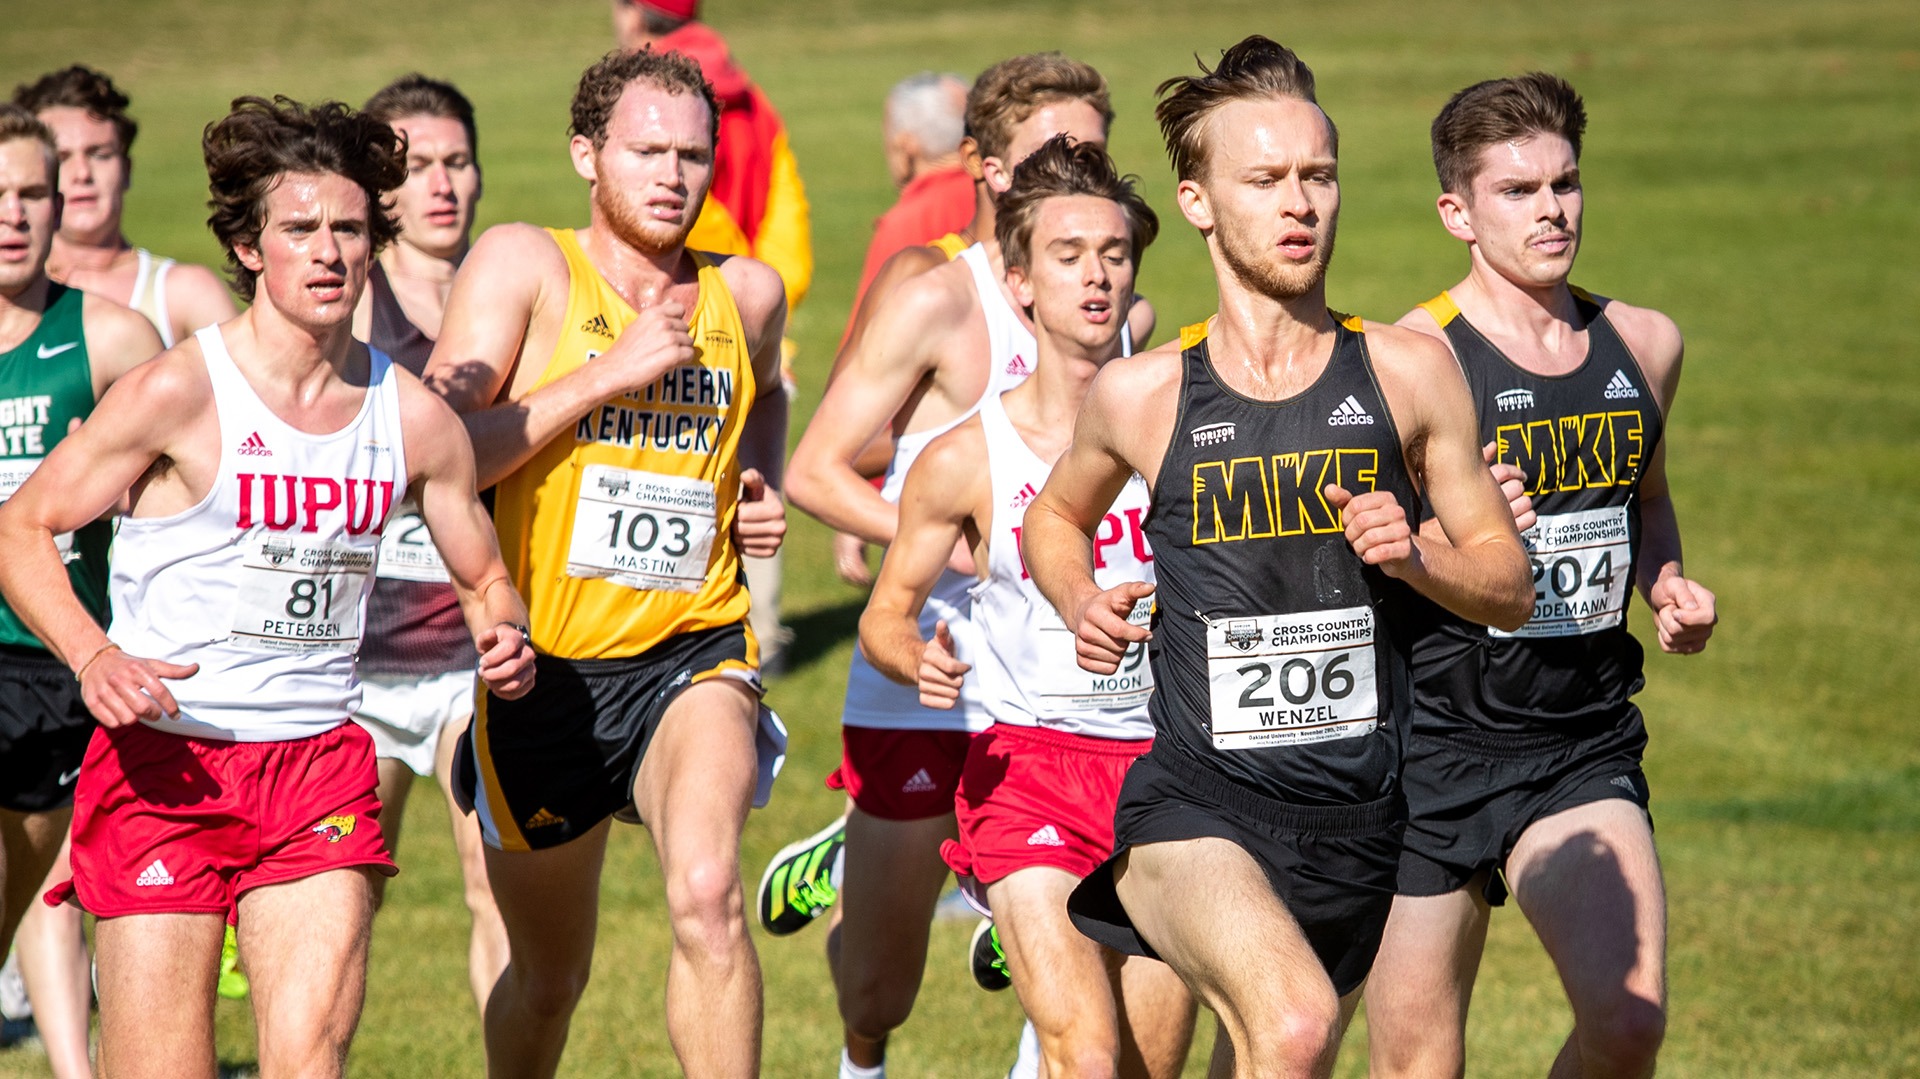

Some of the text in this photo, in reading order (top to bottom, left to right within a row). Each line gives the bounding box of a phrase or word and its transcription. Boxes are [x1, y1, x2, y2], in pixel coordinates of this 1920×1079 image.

[1604, 388, 1639, 399] adidas
[1328, 414, 1374, 426] adidas
[575, 404, 727, 455] KENTUCKY
[1192, 427, 1235, 442] HORIZON
[1194, 435, 1235, 448] LEAGUE
[237, 447, 272, 456] adidas
[1497, 410, 1643, 496] MKE
[638, 483, 671, 494] CROSS
[1192, 448, 1379, 545] MKE
[236, 473, 394, 536] IUPUI
[636, 492, 715, 510] CHAMPIONSHIPS
[398, 512, 426, 546] 2
[608, 509, 690, 557] 103
[1547, 525, 1580, 535] CROSS
[1583, 517, 1623, 530] COUNTRY
[1546, 527, 1626, 545] CHAMPIONSHIPS
[300, 558, 372, 568] CHAMPIONSHIPS
[304, 549, 373, 559] CROSS COUNTRY
[613, 554, 677, 574] MASTIN
[286, 578, 332, 619] 81
[1532, 597, 1609, 618] ODEMANN
[263, 620, 340, 637] PETERSEN
[1273, 618, 1370, 636] CROSS COUNTRY
[1272, 628, 1371, 647] CHAMPIONSHIPS
[1093, 675, 1142, 692] MOON
[1236, 653, 1355, 708] 206
[1259, 705, 1338, 726] WENZEL
[1271, 732, 1296, 740] University
[1300, 729, 1323, 737] November
[136, 876, 174, 886] adidas
